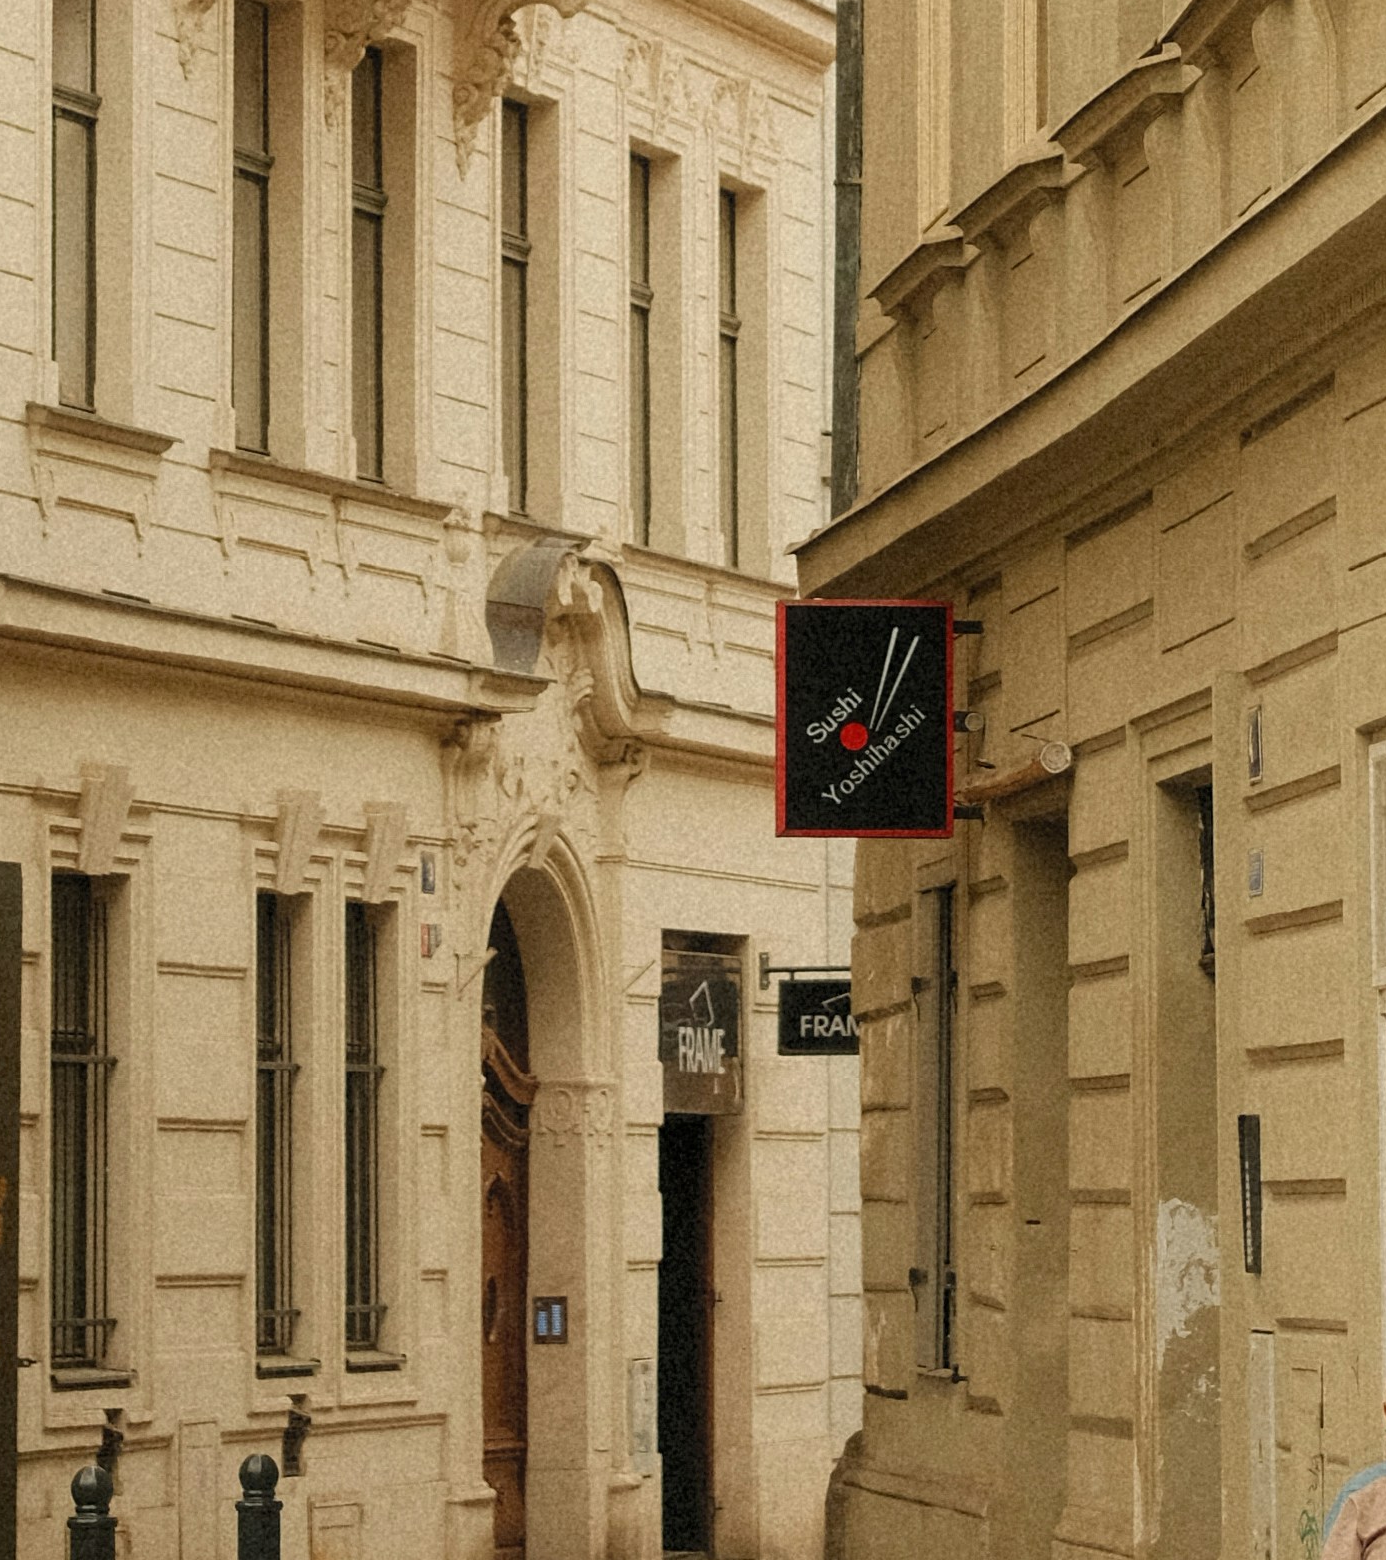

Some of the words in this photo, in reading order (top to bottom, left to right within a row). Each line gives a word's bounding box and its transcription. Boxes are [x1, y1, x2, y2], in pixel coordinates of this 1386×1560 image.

[806, 686, 864, 744] Sushi
[821, 704, 927, 805] Yoshihashi
[678, 1026, 726, 1075] FRAME
[799, 1015, 860, 1038] FRAM
